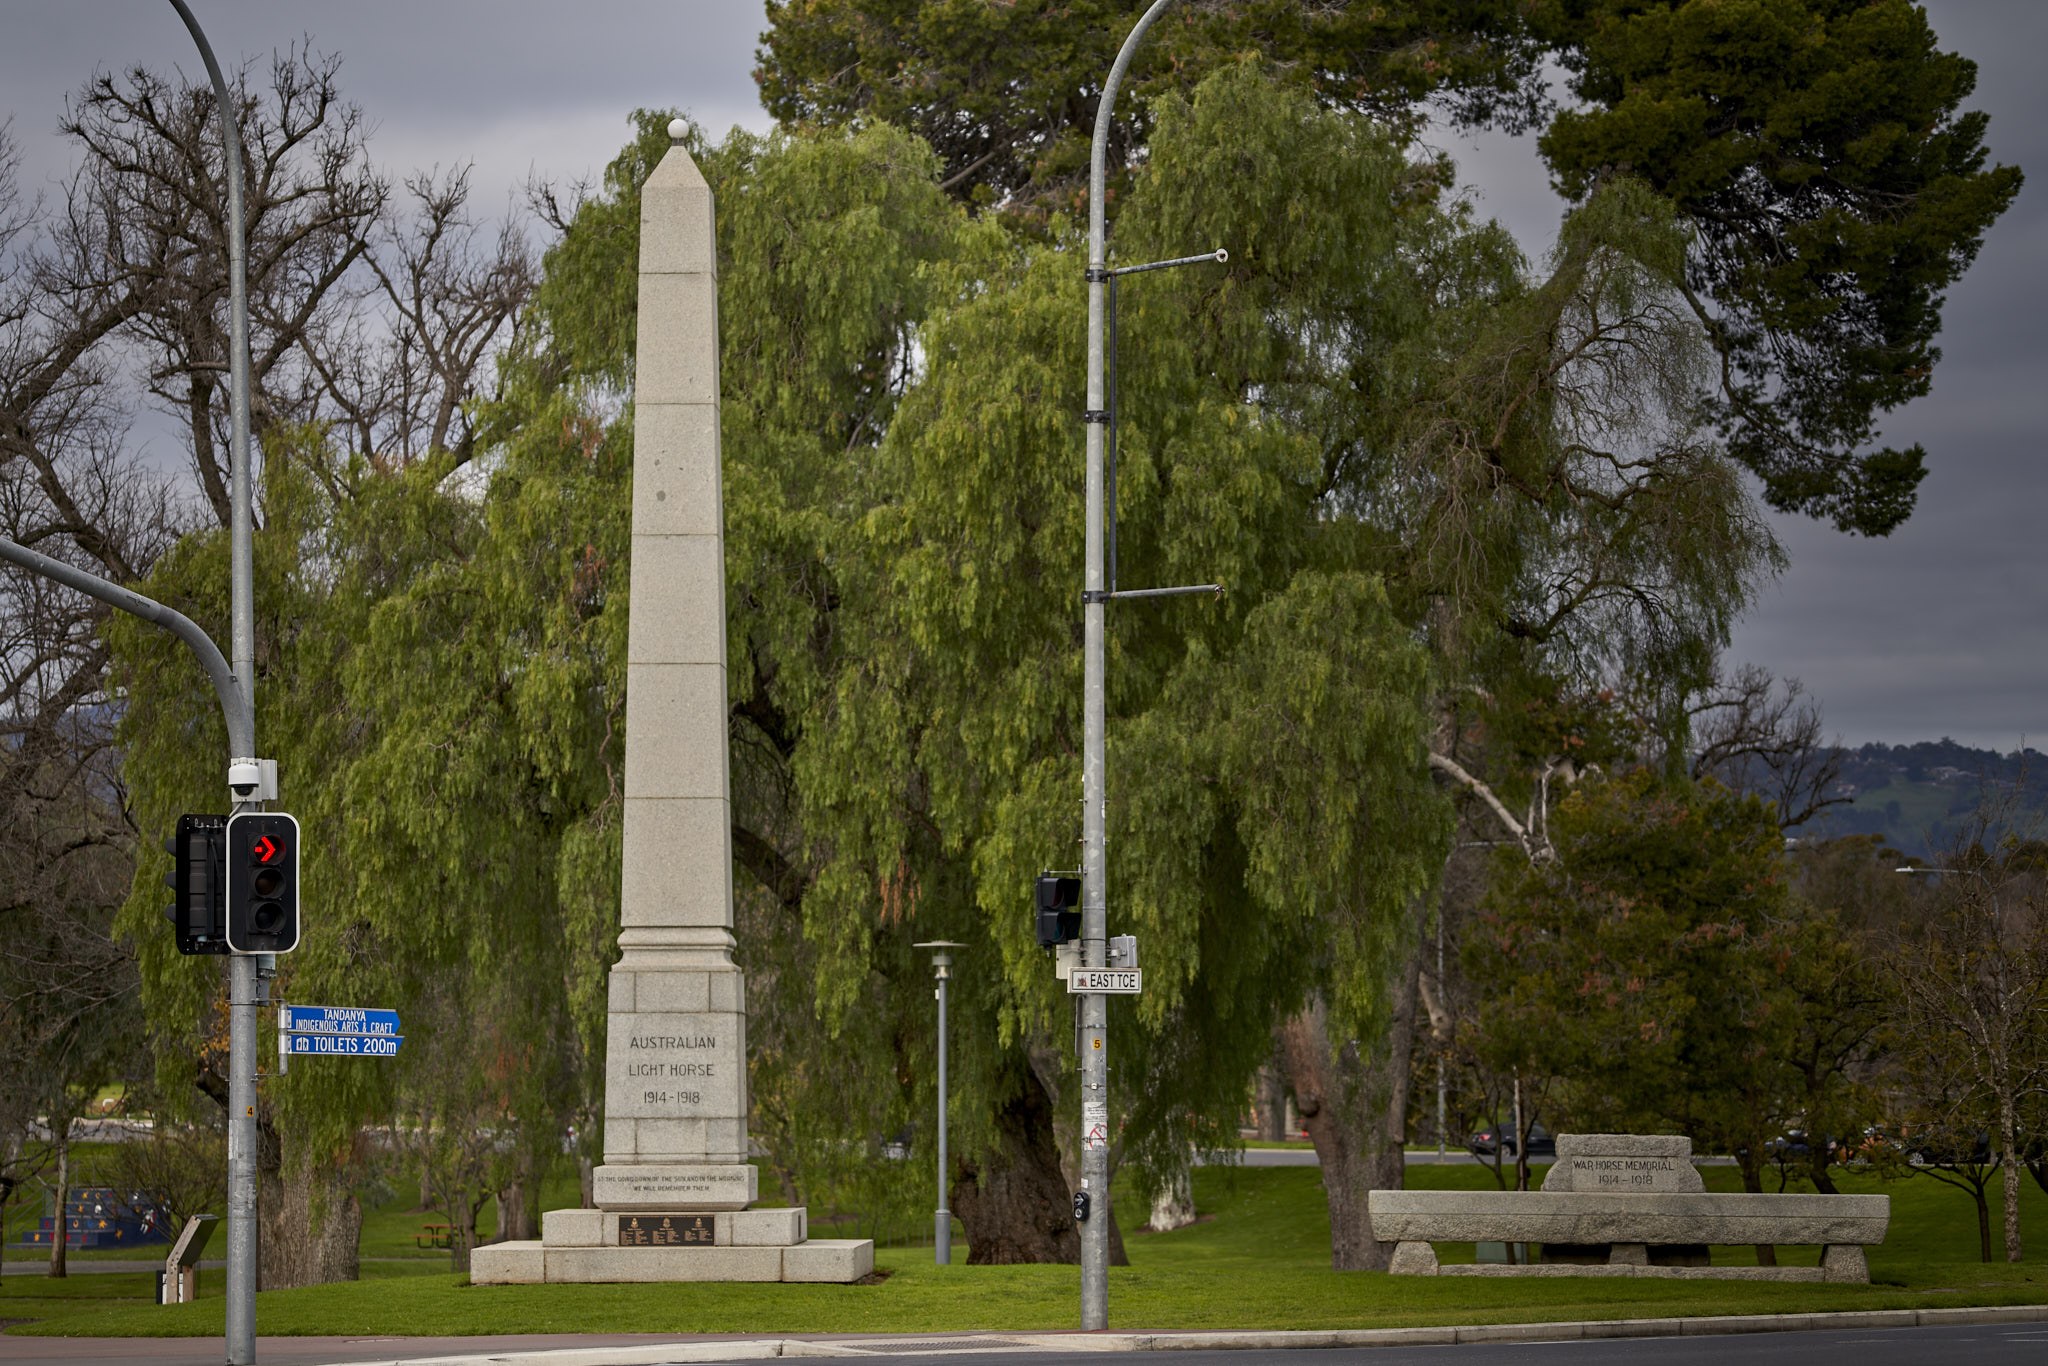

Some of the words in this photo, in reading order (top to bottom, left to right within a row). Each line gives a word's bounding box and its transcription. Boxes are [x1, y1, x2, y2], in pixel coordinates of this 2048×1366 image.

[1090, 974, 1115, 987] EAST
[1117, 974, 1135, 987] TCE
[324, 1009, 366, 1021] TANDANYA
[296, 1019, 338, 1031] INDIGENOUS
[341, 1021, 359, 1032] ARTS
[362, 1022, 367, 1033] &
[370, 1022, 393, 1034] CRAFT
[314, 1037, 358, 1052] TOILETS
[363, 1038, 396, 1053] 200m
[630, 1036, 716, 1049] AUSTRALIAN
[1094, 1039, 1101, 1049] 5
[629, 1064, 665, 1076] LIGHT
[670, 1064, 715, 1076] HORSE
[247, 1106, 253, 1116] 4
[1573, 1160, 1594, 1171] WAR
[1595, 1160, 1623, 1171] HORSE
[1625, 1160, 1674, 1171] MEMORIAL
